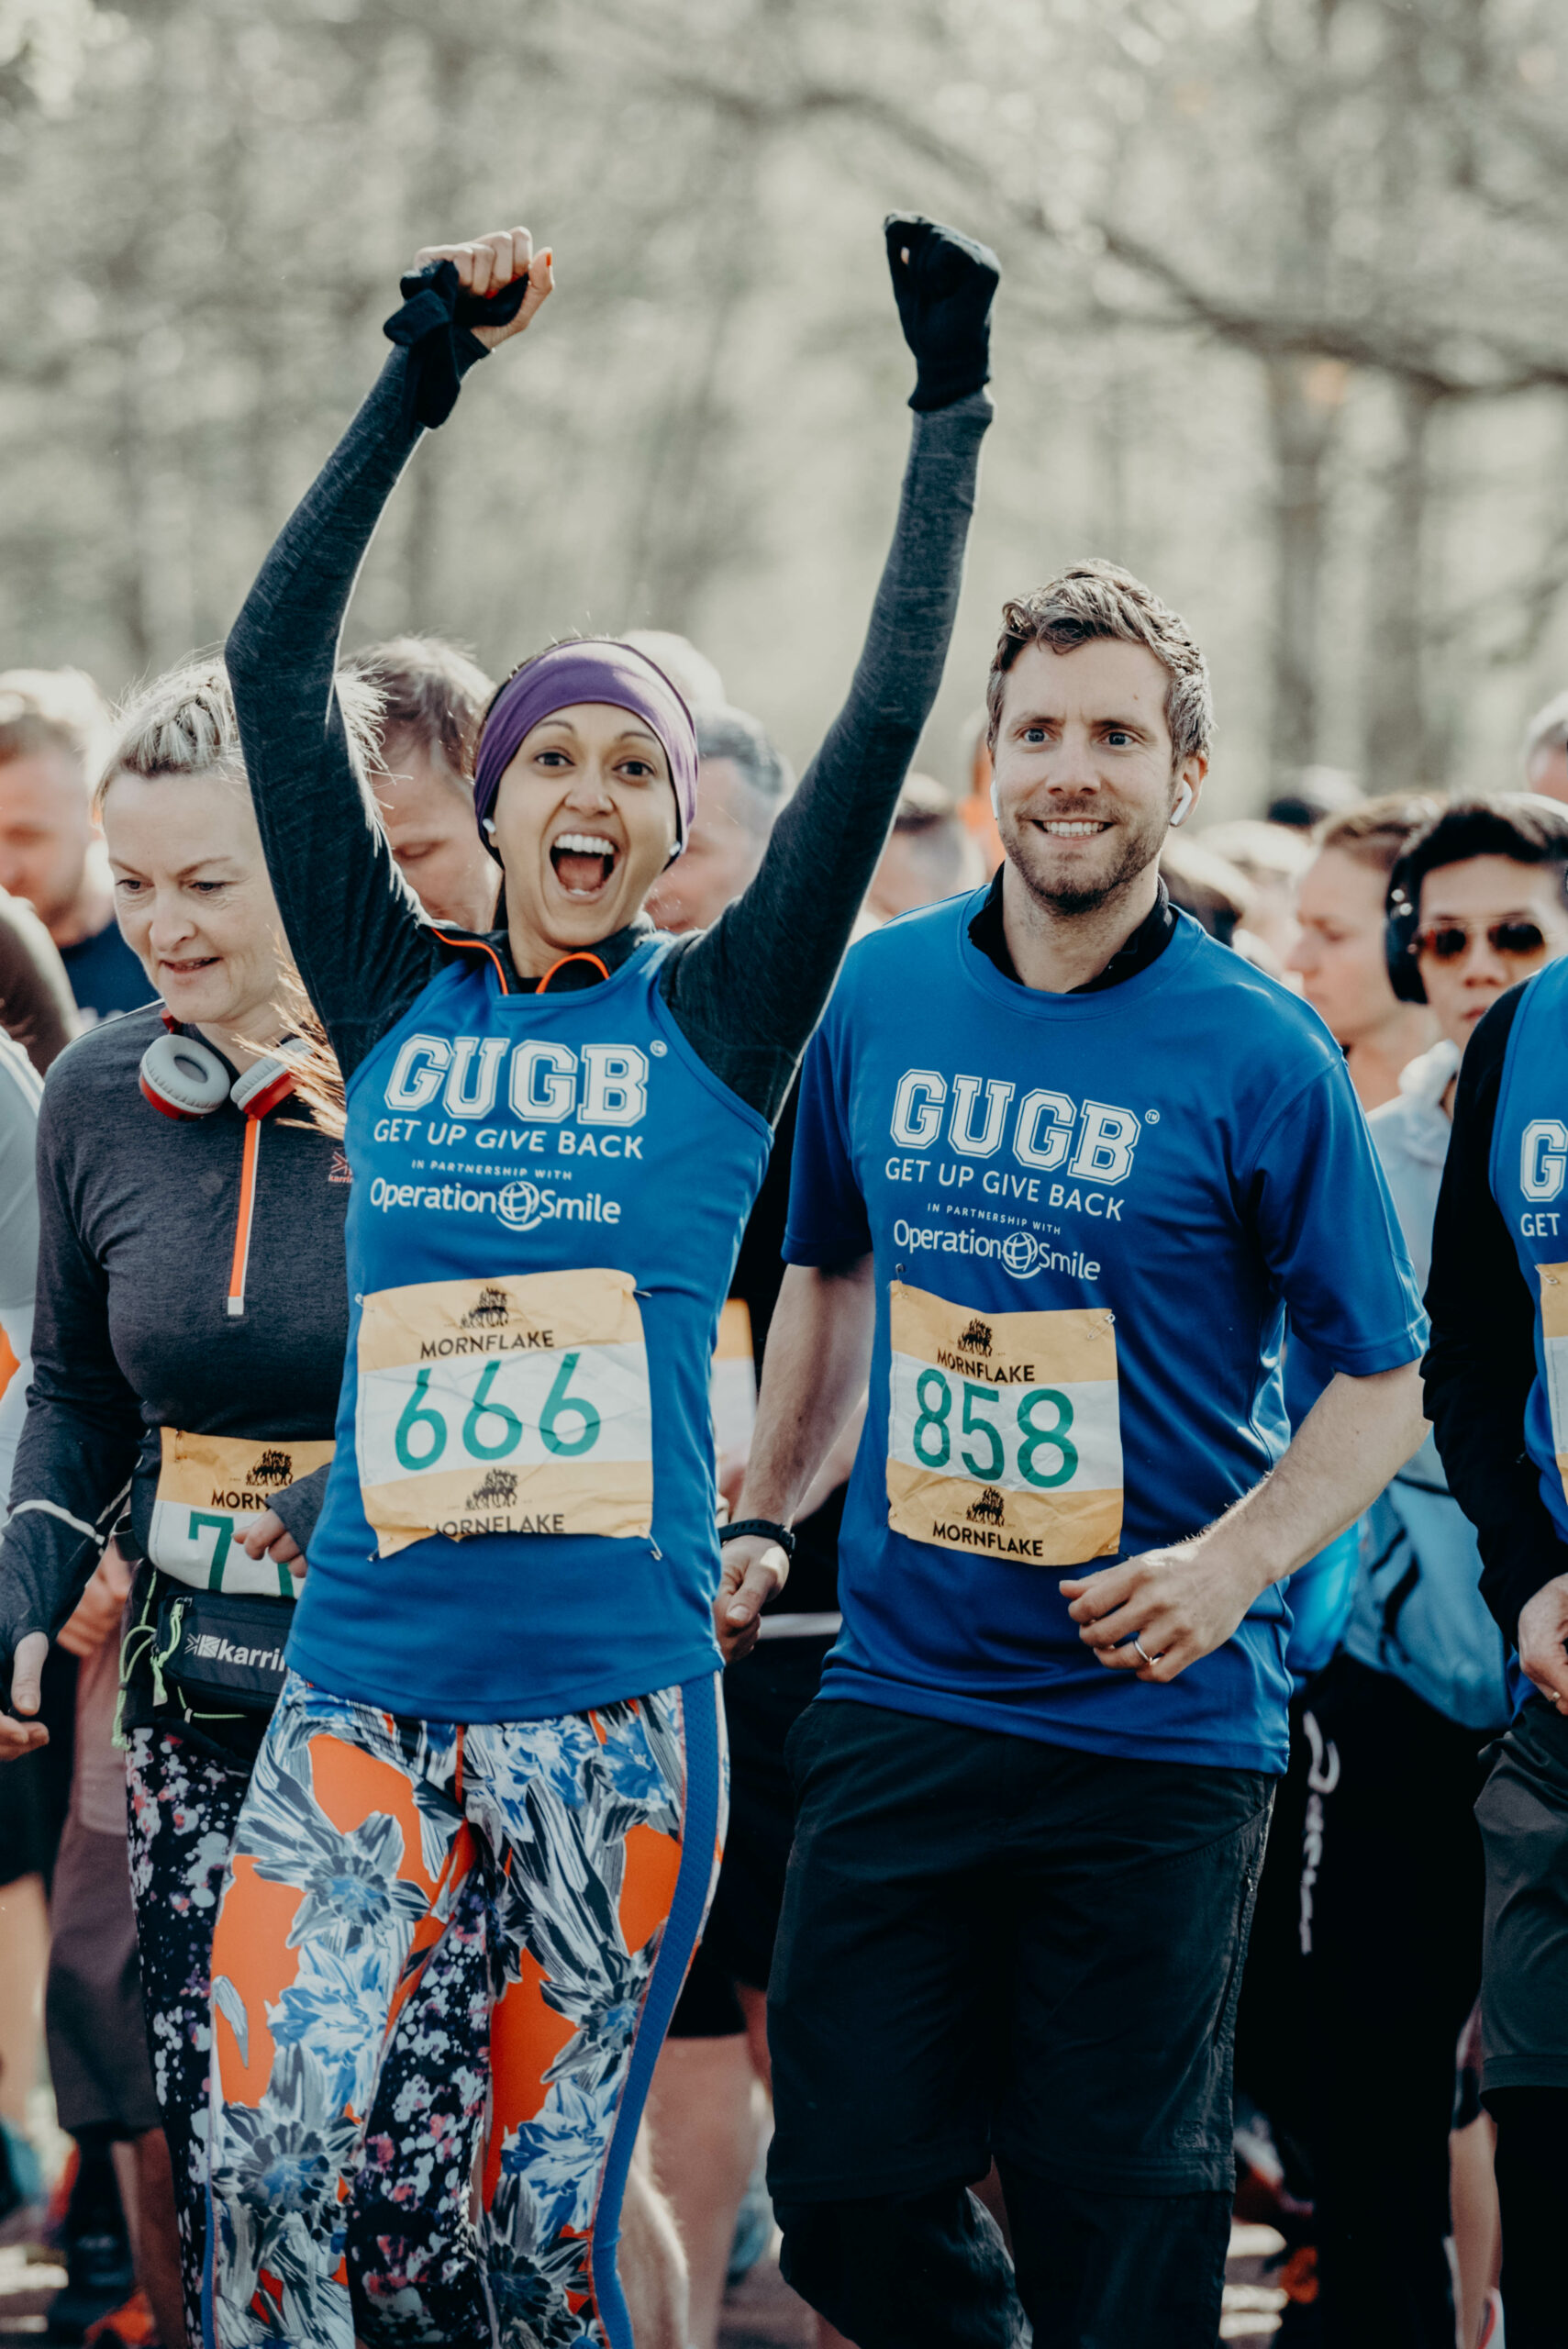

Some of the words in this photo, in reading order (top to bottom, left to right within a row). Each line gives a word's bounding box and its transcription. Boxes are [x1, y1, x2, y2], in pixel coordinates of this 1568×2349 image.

[384, 1033, 650, 1127] GUGB
[373, 1119, 421, 1142] GET
[428, 1121, 467, 1146] UP
[475, 1129, 546, 1152] GIVE
[558, 1130, 644, 1159] BACK
[890, 1068, 1141, 1186] GUGB
[411, 1159, 425, 1170] IN
[430, 1160, 528, 1178] PARTNERSHIP
[535, 1169, 573, 1181] WITH
[885, 1157, 930, 1183] GET
[939, 1163, 973, 1188] UP
[983, 1171, 1041, 1203] GIVE
[1049, 1184, 1125, 1221] BACK
[370, 1177, 496, 1212] Operation
[539, 1189, 621, 1224] Smile
[928, 1203, 940, 1212] IN
[946, 1205, 1028, 1228] PARTNERSHIP
[1032, 1221, 1062, 1236] WITH
[1520, 1213, 1561, 1237] GET
[894, 1219, 1003, 1261] Operation
[1039, 1242, 1101, 1281] Smile
[419, 1330, 554, 1360] MORNFLAKE
[936, 1347, 1035, 1384] MORNFLAKE
[395, 1353, 600, 1471] 666
[913, 1368, 1079, 1488] 858
[426, 1513, 565, 1538] ORNFLAKE
[932, 1520, 1044, 1557] MORNFLAKE
